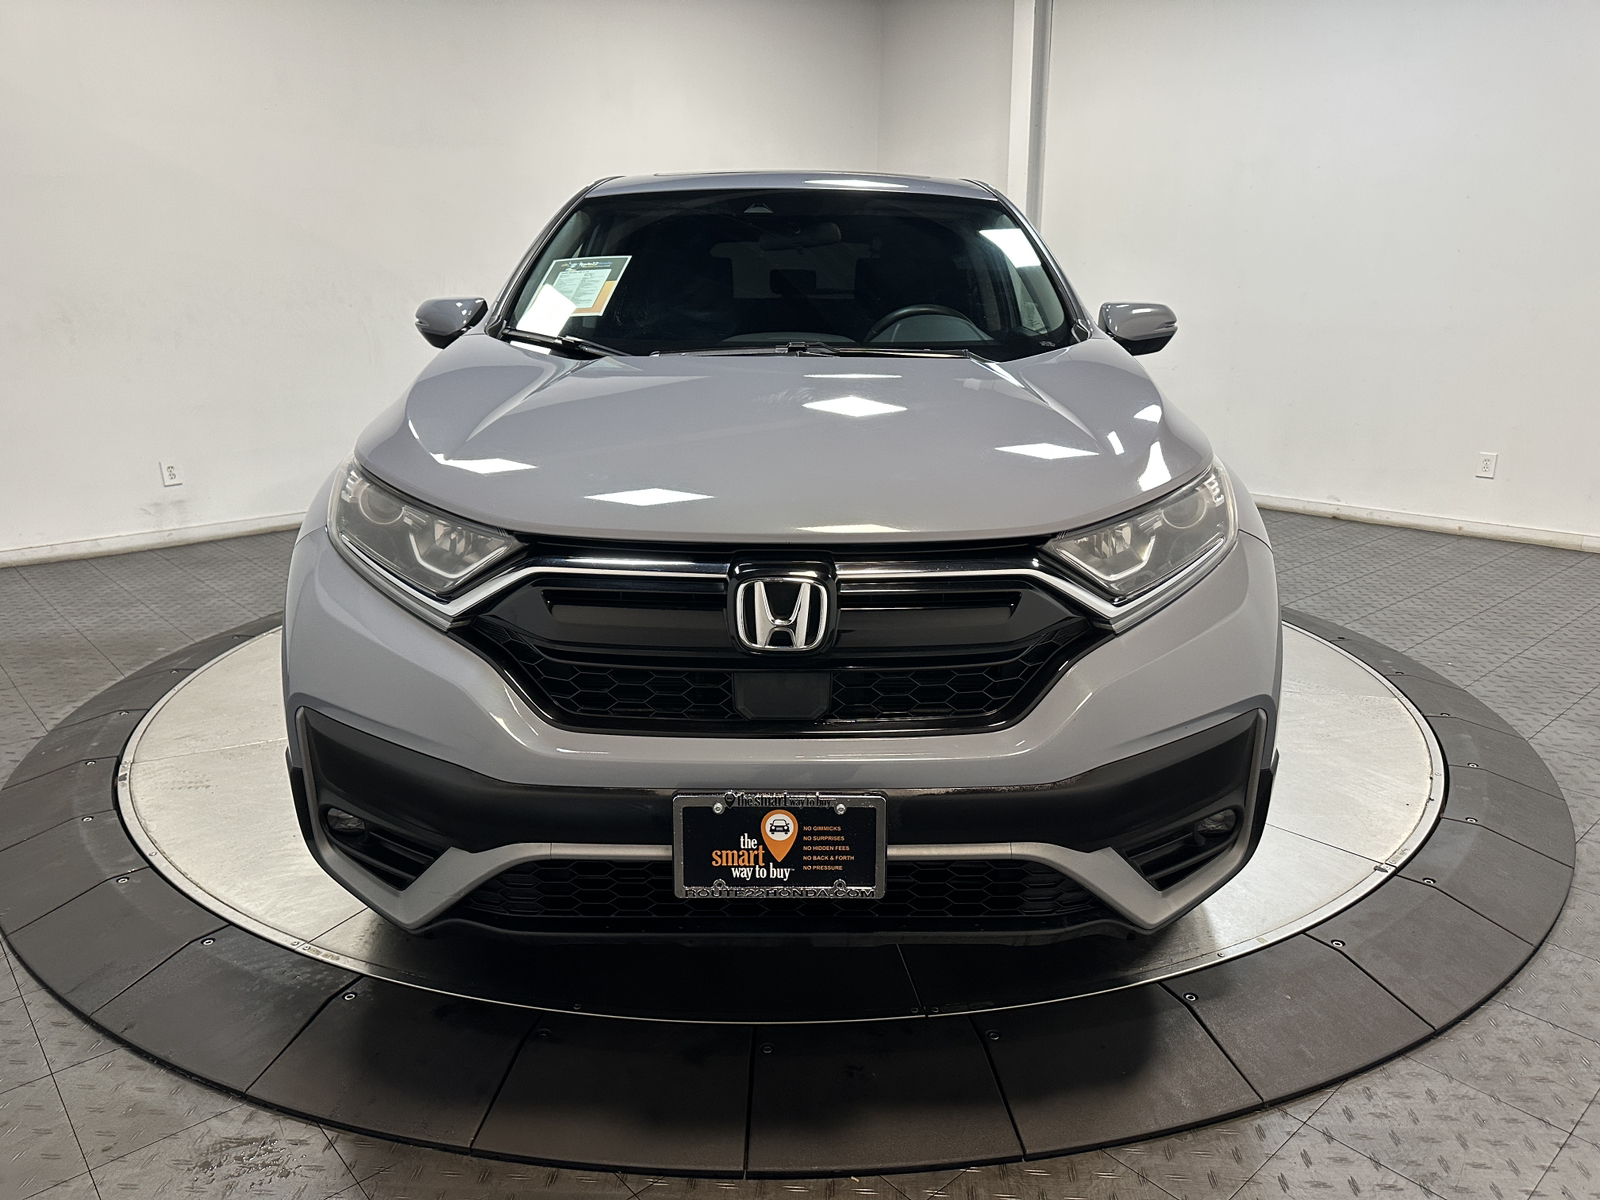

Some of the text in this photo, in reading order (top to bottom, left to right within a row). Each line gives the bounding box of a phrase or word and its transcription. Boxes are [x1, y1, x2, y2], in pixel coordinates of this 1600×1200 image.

[740, 833, 758, 849] the
[711, 845, 765, 867] smart
[731, 862, 791, 881] way to buy
[685, 887, 875, 898] ROUTE22HONDA.COM
